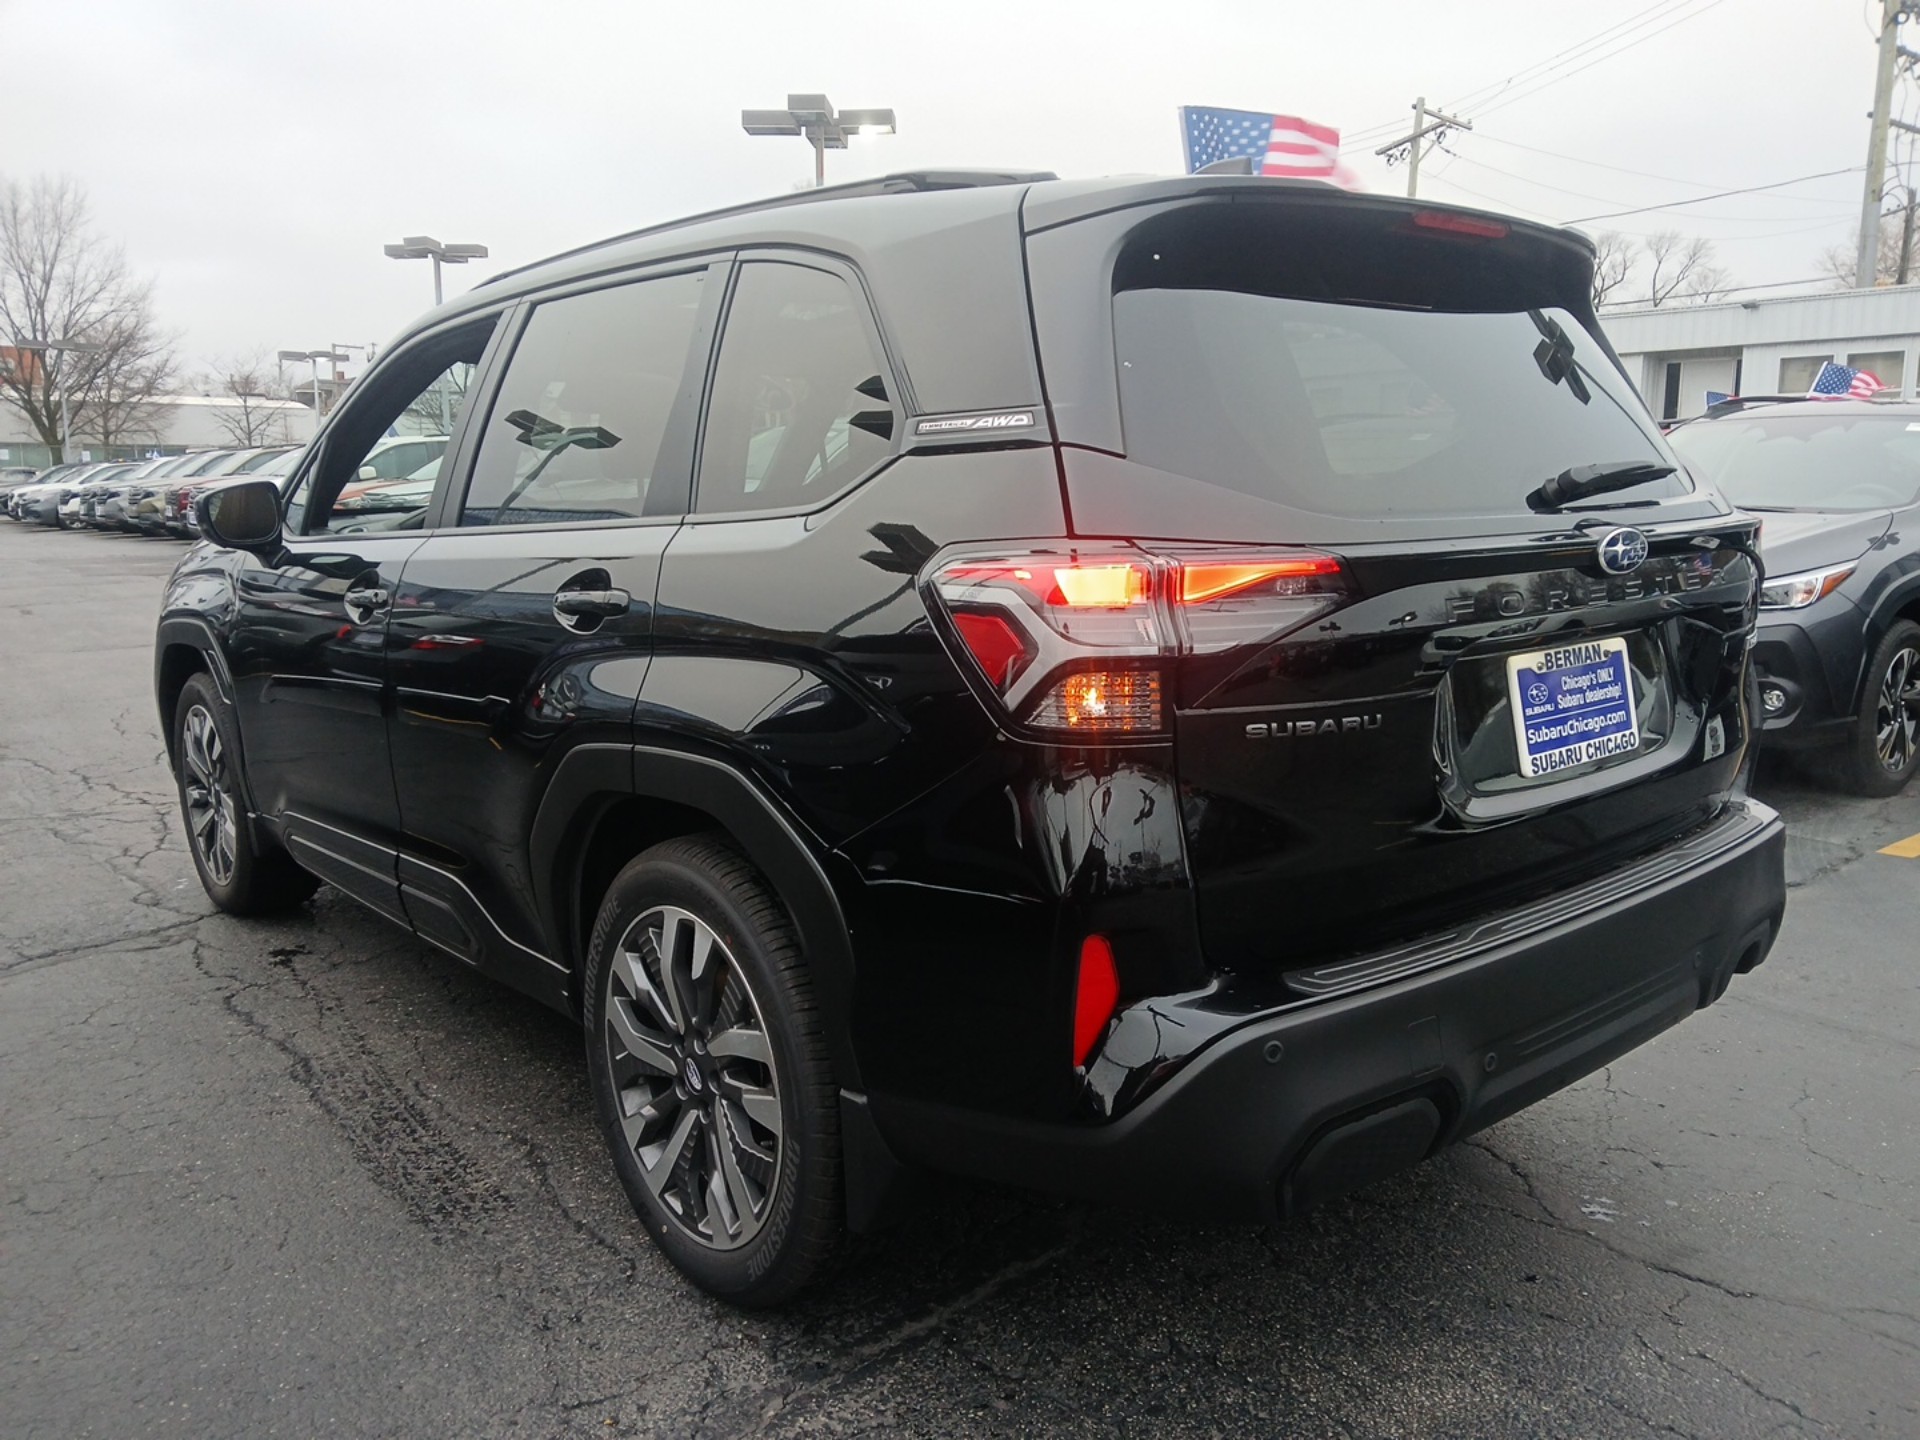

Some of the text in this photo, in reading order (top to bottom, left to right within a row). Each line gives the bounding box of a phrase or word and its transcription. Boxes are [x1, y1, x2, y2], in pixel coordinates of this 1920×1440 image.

[972, 415, 1030, 429] AWD
[1445, 567, 1727, 622] FORESTER
[1544, 644, 1601, 671] BERMAN
[1561, 667, 1615, 691] Chicago's ONLY
[1557, 682, 1623, 709] Subaru dealership!
[1525, 703, 1555, 716] SUBARU
[1245, 714, 1382, 739] SUBARU
[1527, 710, 1627, 745] SubaruChicago.com
[1531, 731, 1637, 775] SUBARU CHICAGO
[747, 1134, 800, 1281] BRIDGESTONE
